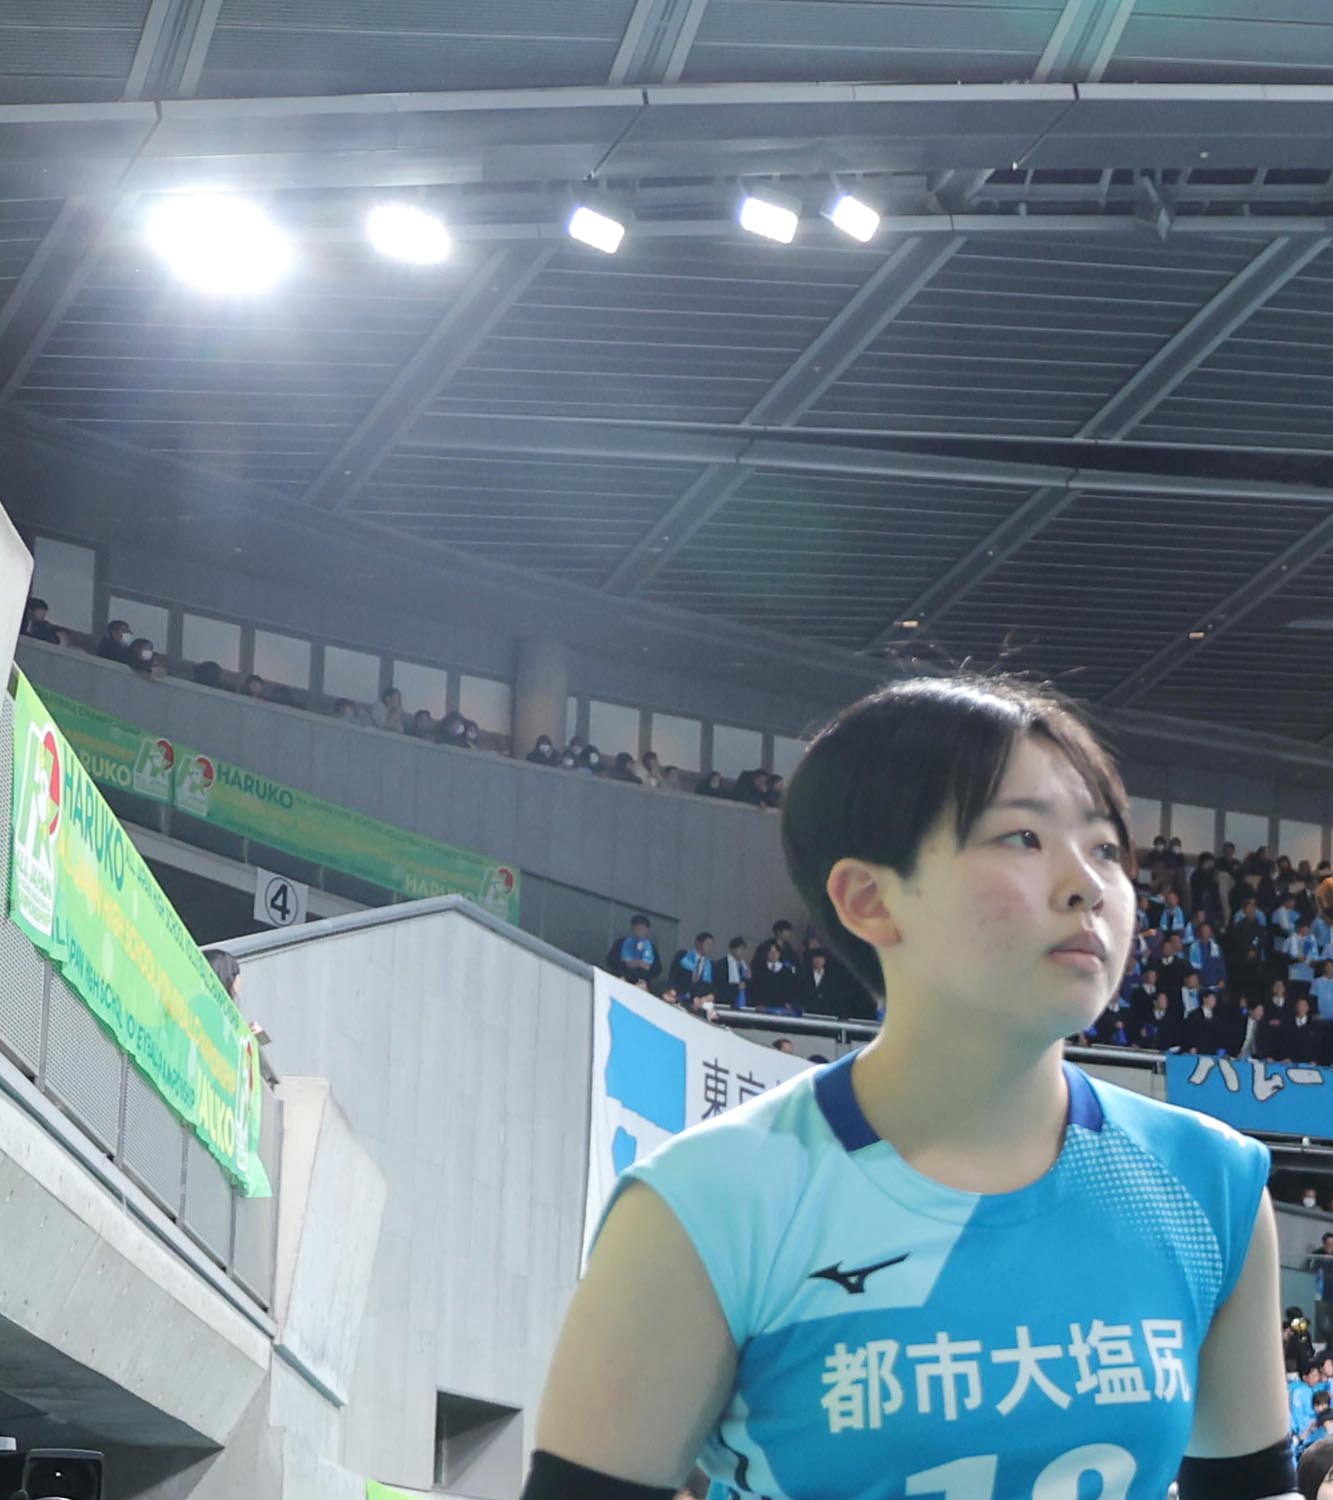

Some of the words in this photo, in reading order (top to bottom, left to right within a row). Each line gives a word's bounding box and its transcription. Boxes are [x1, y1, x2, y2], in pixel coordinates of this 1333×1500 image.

[78, 751, 132, 787] RUKO
[218, 762, 294, 809] HARUKO
[63, 741, 124, 891] HARUKO
[267, 881, 294, 924] 4
[821, 1318, 1191, 1434] 都市大塩尻
